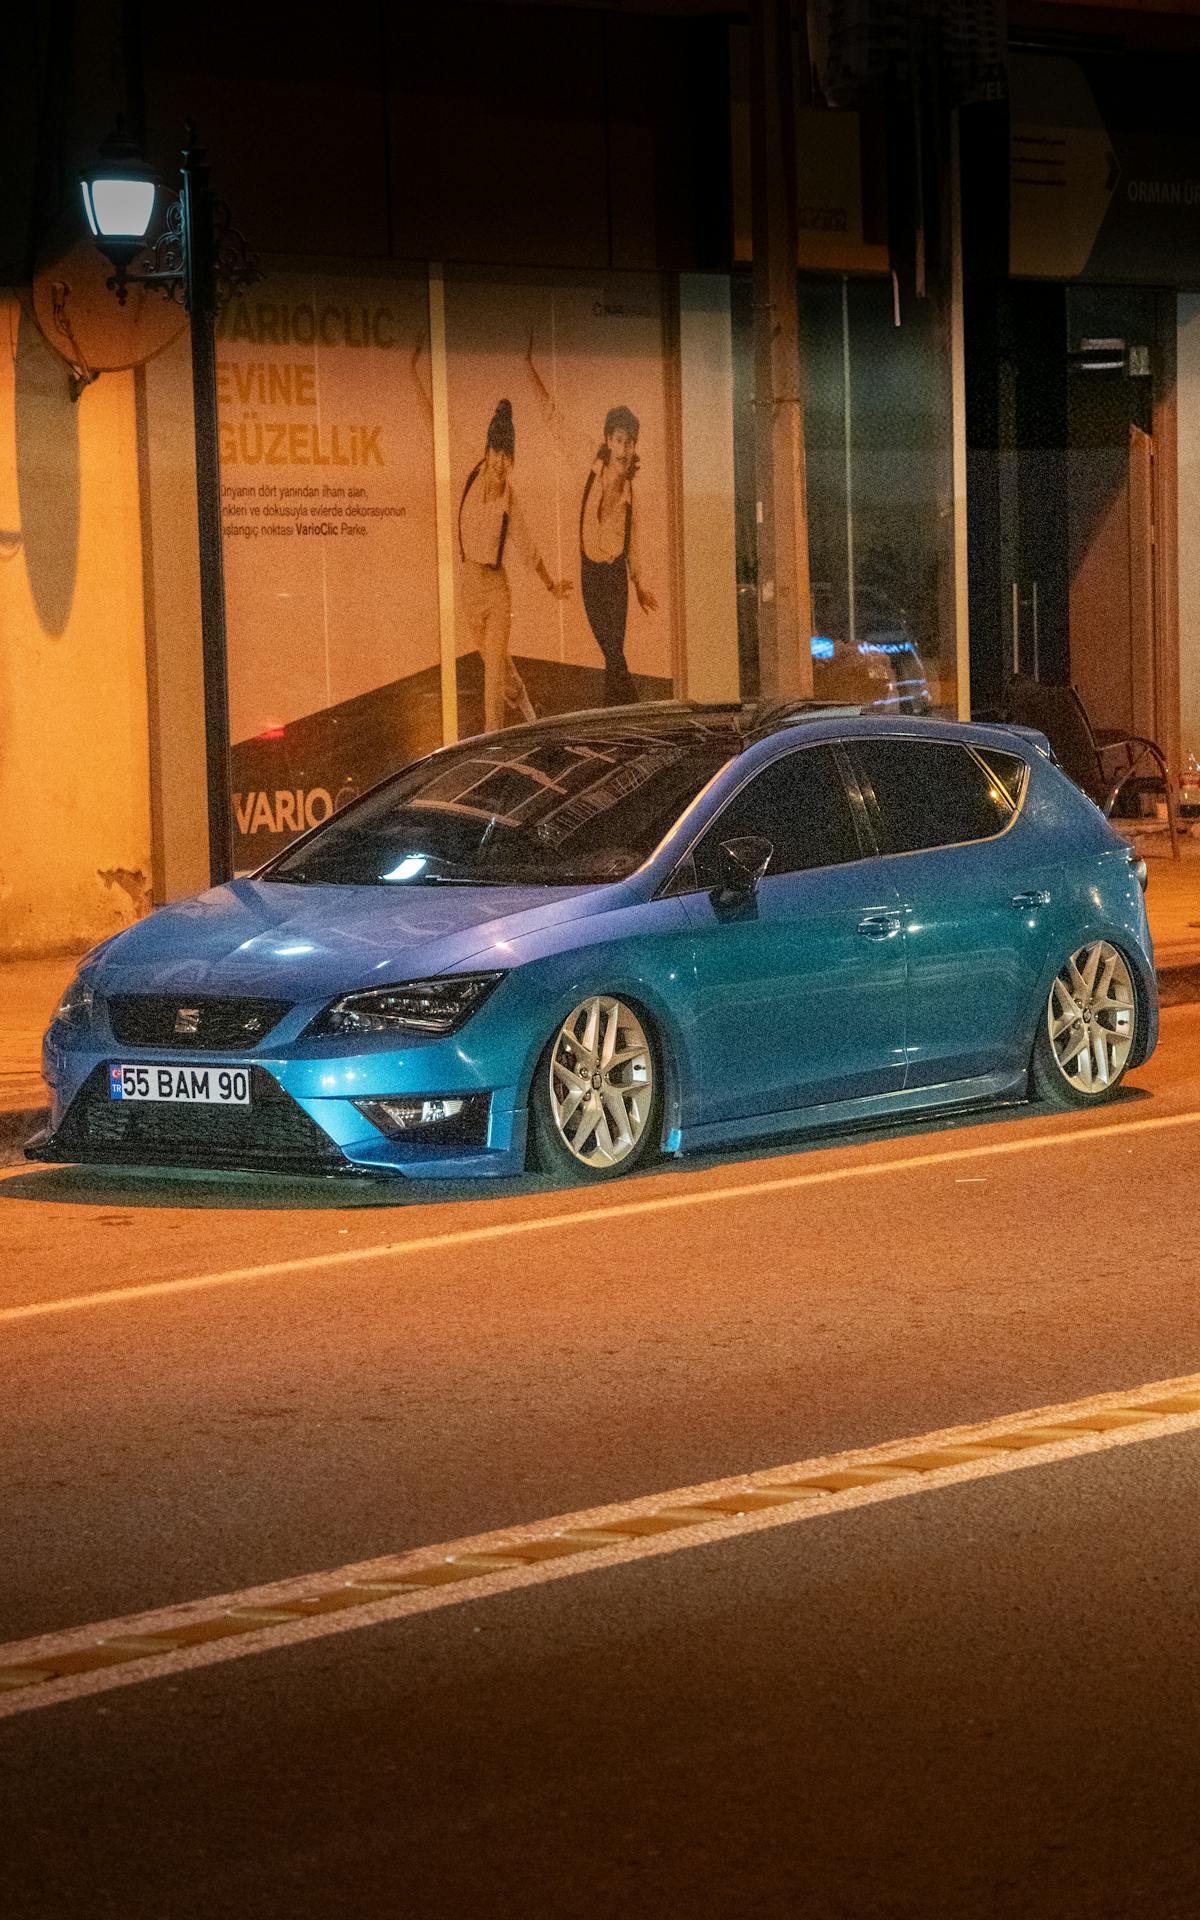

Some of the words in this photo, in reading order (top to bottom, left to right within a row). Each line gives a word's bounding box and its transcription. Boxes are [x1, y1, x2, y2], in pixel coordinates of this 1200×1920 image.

[1127, 179, 1181, 206] ORMAN
[249, 506, 260, 517] ve
[262, 503, 308, 520] dokusuyla
[310, 504, 342, 517] evlerde
[345, 504, 406, 520] dekorasyonun
[295, 522, 339, 536] VarioClic
[112, 1083, 122, 1093] TR
[123, 1067, 150, 1097] 55
[157, 1069, 210, 1100] BAM
[218, 1071, 247, 1101] 90
